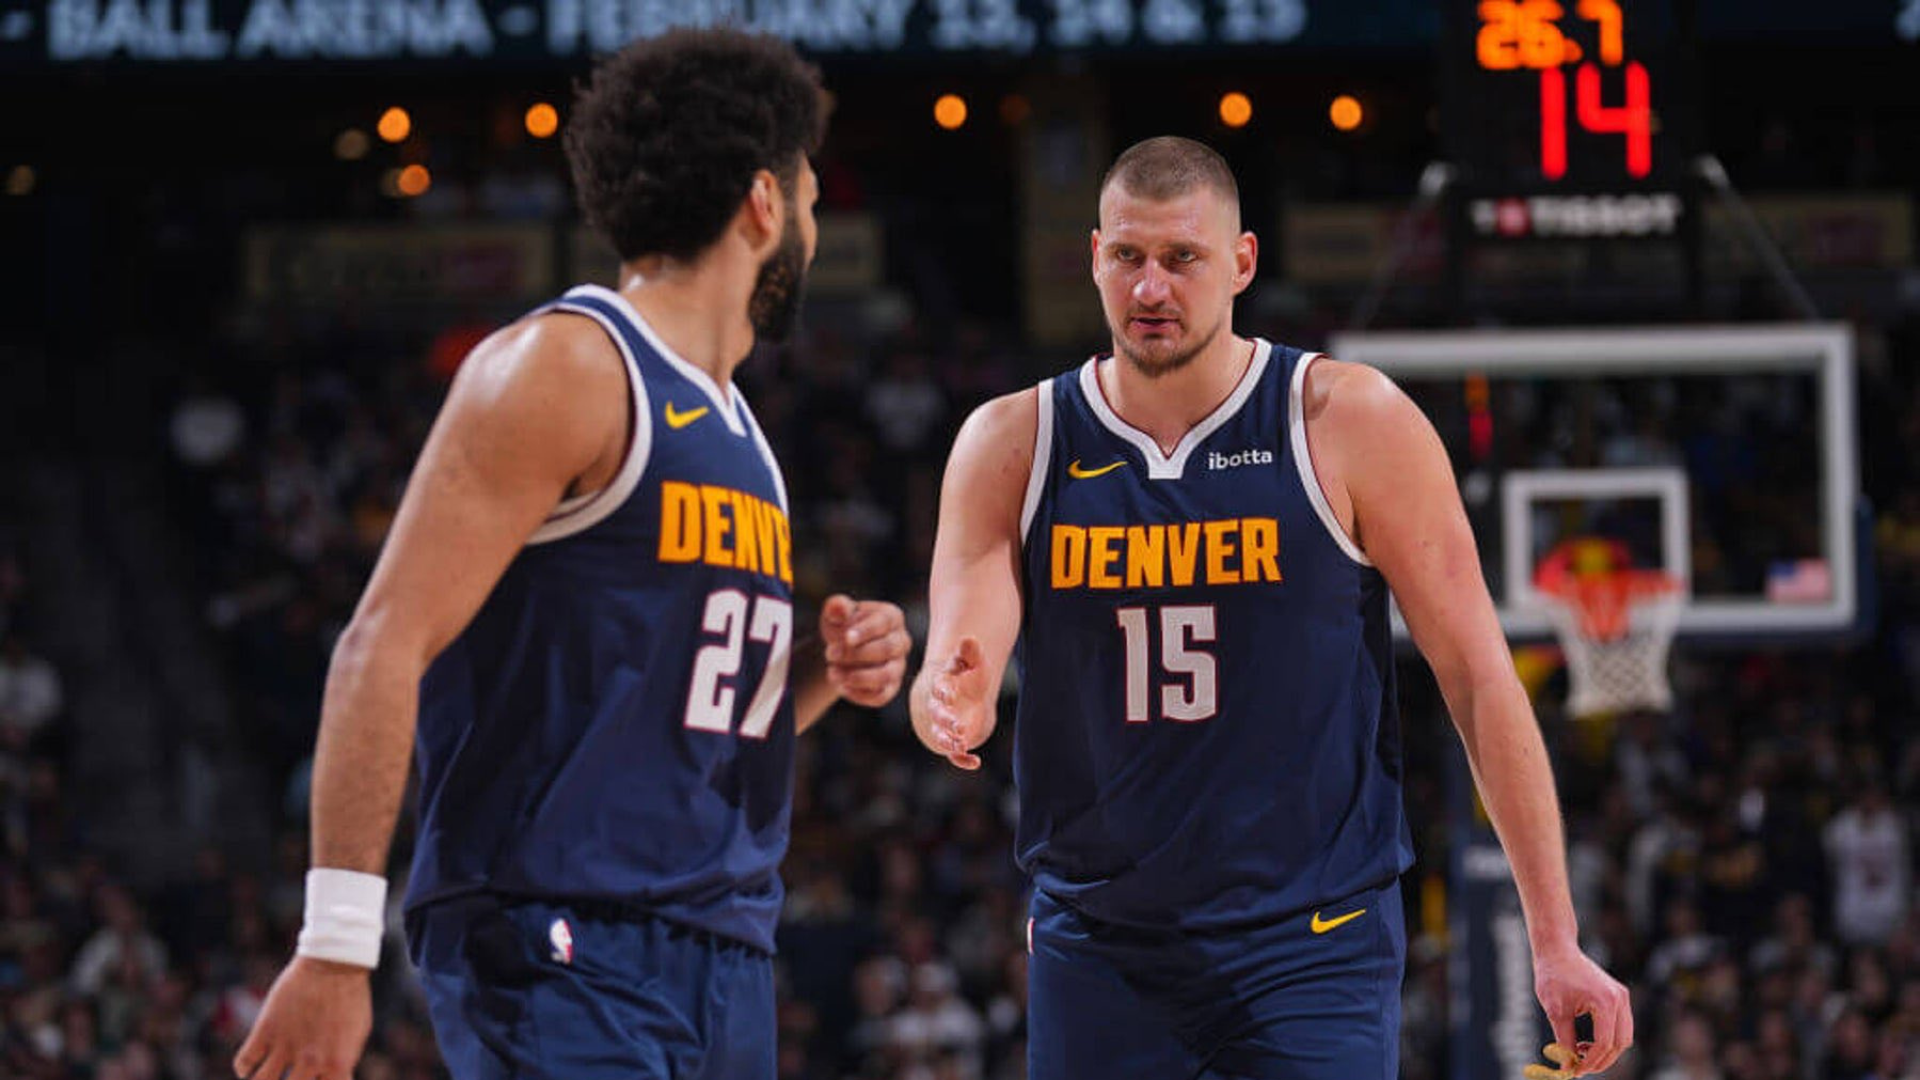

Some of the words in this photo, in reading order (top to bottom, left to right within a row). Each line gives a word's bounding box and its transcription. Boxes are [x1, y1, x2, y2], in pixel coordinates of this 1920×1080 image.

[49, 0, 229, 58] BALL
[237, 0, 495, 56] ARENA
[1477, 0, 1624, 69] 26.7
[1540, 60, 1652, 180] 14
[1208, 449, 1273, 470] ibotta
[1051, 517, 1283, 589] DENVER
[684, 587, 793, 741] 27
[1116, 604, 1217, 723] 15
